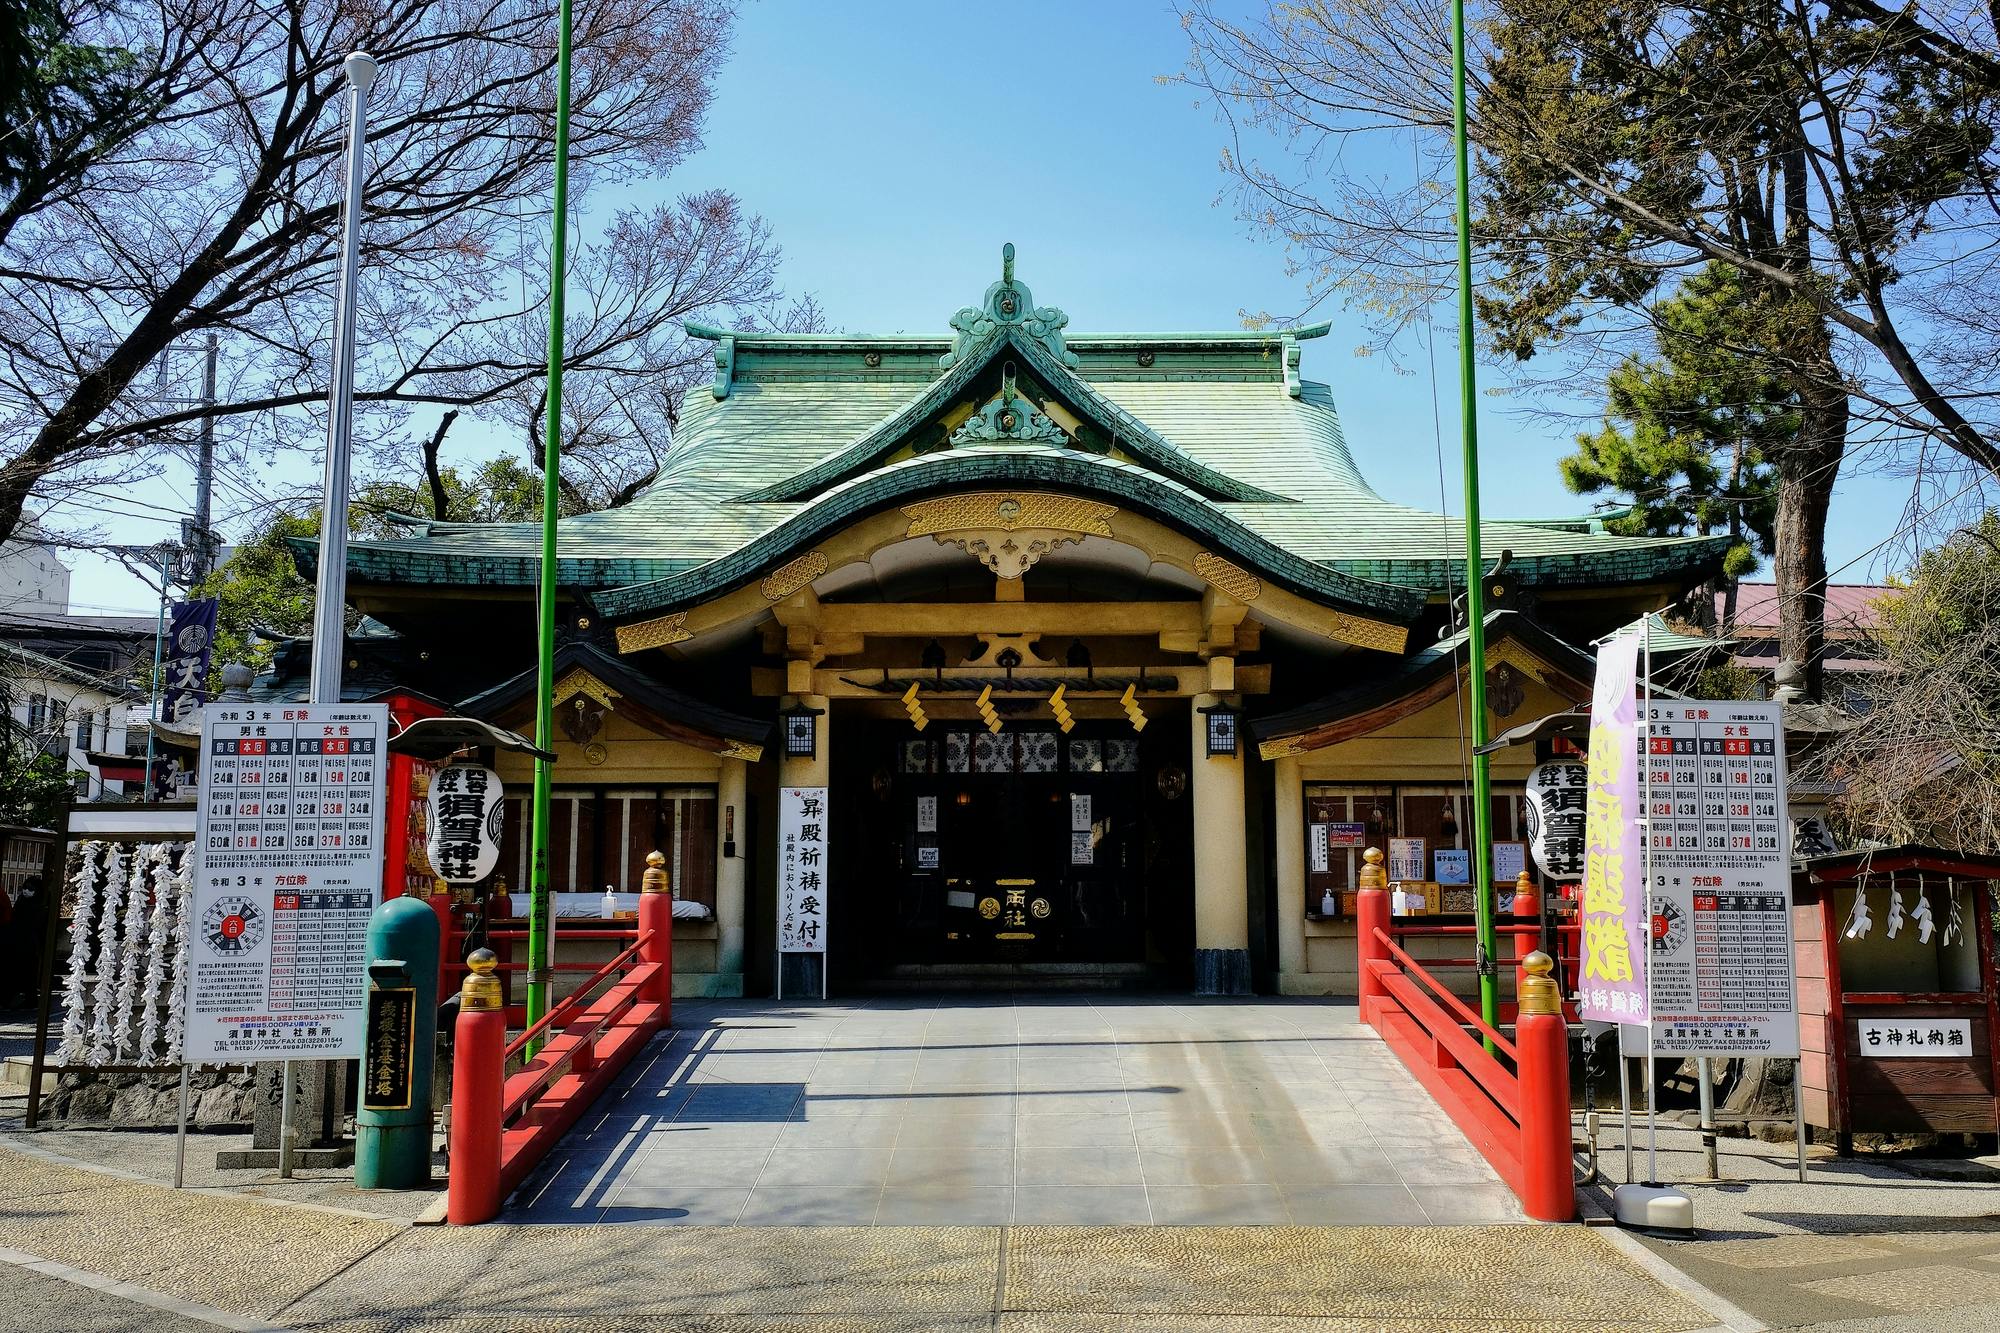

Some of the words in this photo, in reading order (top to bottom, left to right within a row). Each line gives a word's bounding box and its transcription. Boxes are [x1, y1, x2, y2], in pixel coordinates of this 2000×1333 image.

[283, 711, 308, 720] 厄除
[1685, 710, 1709, 719] 厄除
[240, 726, 266, 736] 男性
[324, 726, 350, 735] 女性
[1724, 726, 1749, 736] 女性
[216, 742, 235, 752] 前厄
[244, 742, 262, 752] 本厄
[271, 742, 288, 752] 後厄
[300, 742, 318, 751] 前厄
[327, 742, 344, 751] 本厄
[353, 741, 371, 750] 後厄
[1650, 742, 1668, 751] 本厄
[1676, 742, 1693, 752] 後厄
[1704, 742, 1721, 752] 前厄
[1729, 742, 1746, 752] 本厄
[1754, 743, 1771, 752] 後厄
[214, 760, 235, 768] 平成10年生
[351, 759, 372, 767] 平成14年生
[214, 772, 233, 784] 24歳
[241, 772, 260, 783] 25歳
[268, 772, 288, 783] 26歳
[299, 772, 317, 782] 18歳
[325, 772, 343, 782] 19歳
[351, 771, 370, 782] 20歳
[465, 769, 488, 794] 四谷
[1565, 765, 1587, 787] 四谷
[1651, 772, 1669, 783] 25歳
[1677, 772, 1695, 783] 26歳
[1705, 773, 1722, 783] 18歳
[1730, 773, 1747, 783] 19歳
[1755, 773, 1772, 784] 20歳
[212, 804, 231, 815] 41歳
[239, 804, 259, 815] 42歳
[267, 804, 286, 815] 43歳
[296, 804, 315, 814] 32歳
[323, 803, 342, 814] 33歳
[350, 803, 369, 814] 34歳
[1653, 804, 1671, 815] 42歳
[1678, 804, 1696, 815] 43歳
[1706, 805, 1723, 815] 32歳
[1731, 805, 1749, 815] 33歳
[1756, 805, 1774, 816] 34歳
[438, 794, 486, 879] 須賀神社
[1541, 788, 1588, 875] 須賀神社
[210, 836, 229, 848] 60歳
[238, 836, 257, 847] 61歳
[265, 836, 284, 847] 62歳
[294, 835, 314, 846] 36歳
[322, 835, 340, 846] 37歳
[349, 835, 367, 846] 38歳
[1654, 836, 1672, 847] 61歳
[1680, 836, 1697, 847] 62歳
[1707, 837, 1725, 847] 36歳
[1732, 837, 1750, 848] 37歳
[1758, 837, 1776, 848] 38歳
[798, 799, 823, 940] 昇殿祈祷受付
[275, 875, 307, 885] 方位除
[1692, 877, 1722, 886] 方位除
[784, 834, 796, 941] 社殿内にお入りください
[229, 1028, 281, 1039] 須賀神社
[294, 1027, 331, 1037] 社務所
[1664, 1029, 1713, 1037] 須賀神社
[1724, 1029, 1759, 1037] 社務所
[1866, 1028, 1964, 1046] 古神札納箱
